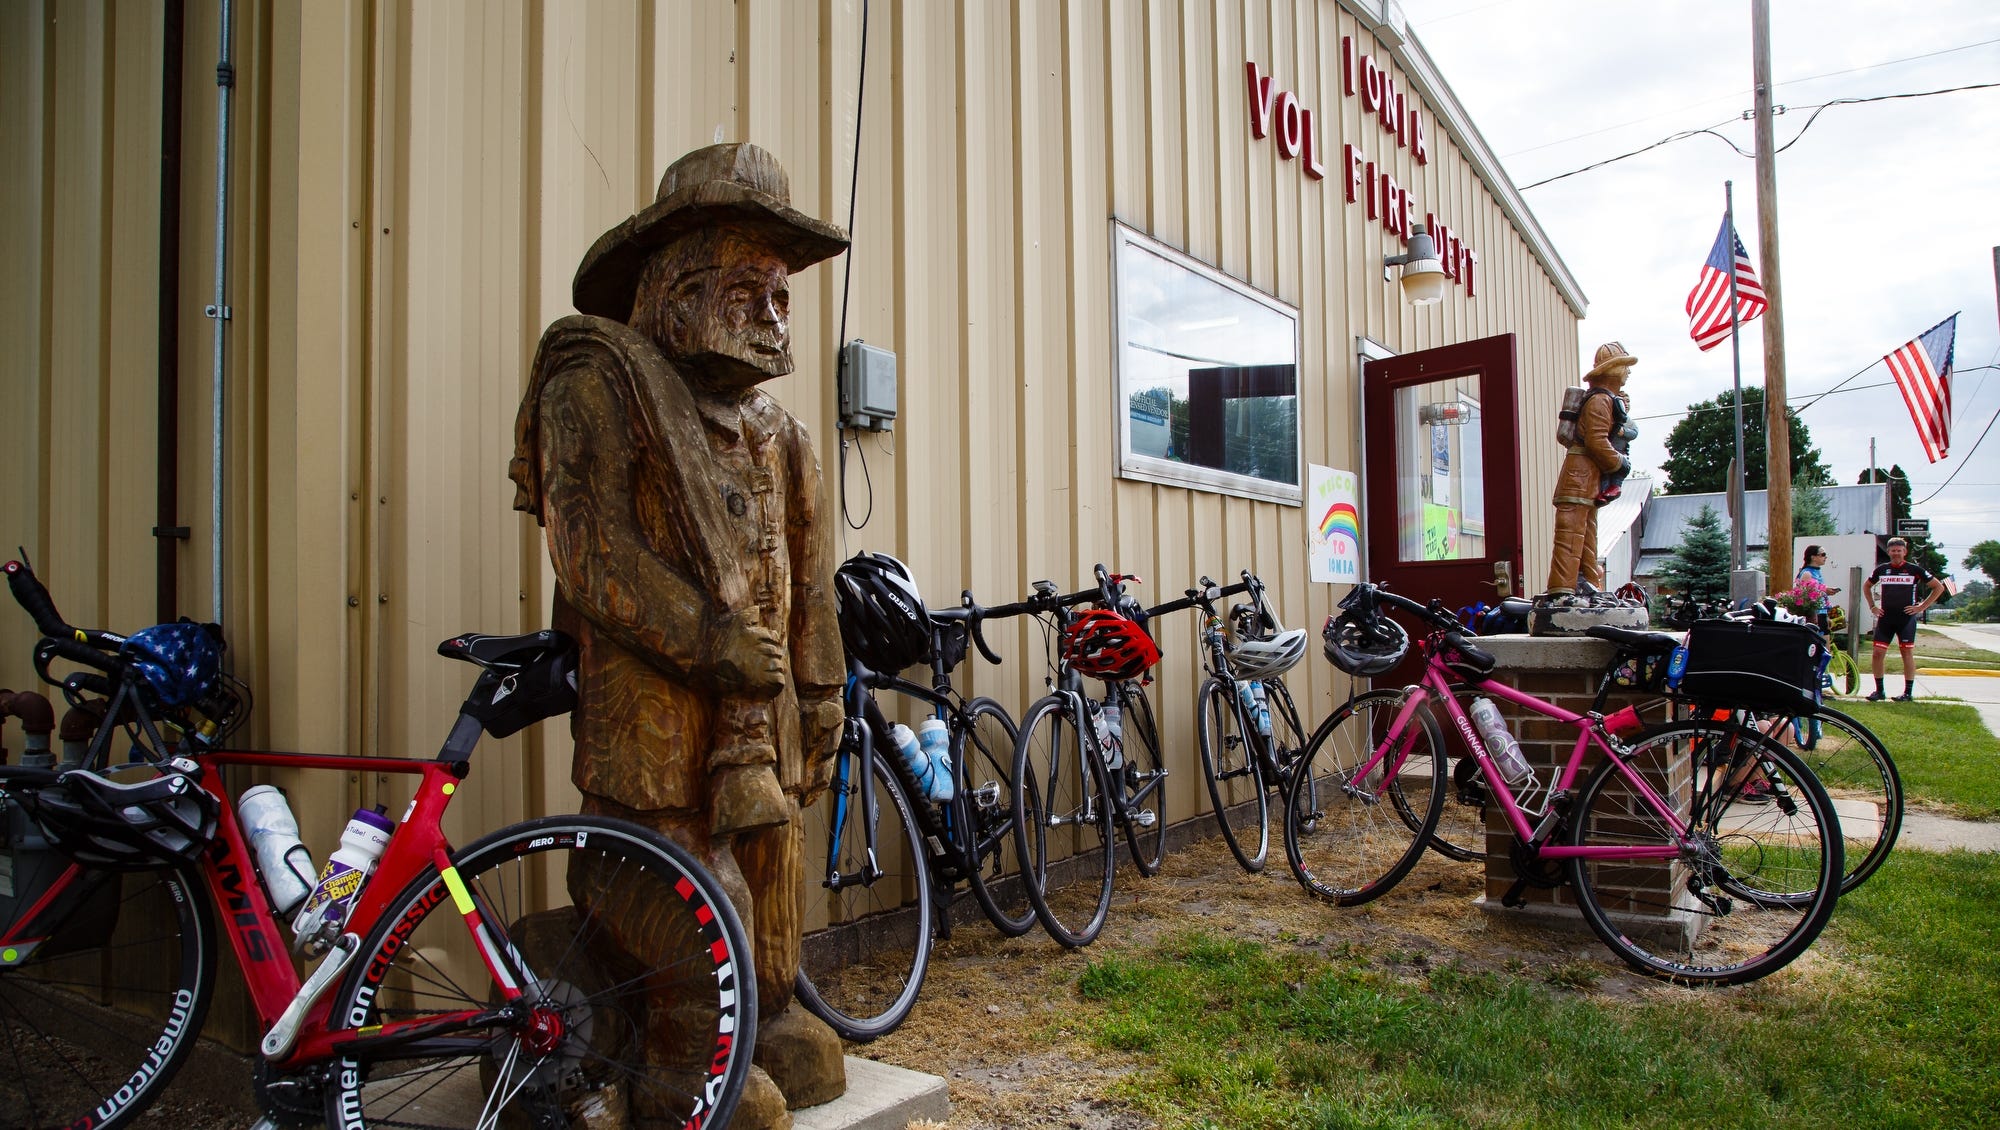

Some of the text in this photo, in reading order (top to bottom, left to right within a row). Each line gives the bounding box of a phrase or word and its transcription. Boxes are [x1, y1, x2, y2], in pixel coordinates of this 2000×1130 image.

[1342, 36, 1428, 166] IONIA
[1246, 61, 1478, 297] VOL FIRE DEPT
[1318, 474, 1357, 500] WELCO
[1332, 539, 1346, 555] TO
[1328, 558, 1354, 574] IONIA
[888, 592, 909, 613] GIRO
[101, 632, 127, 643] PROF
[1457, 715, 1487, 759] GUNNAR
[528, 836, 555, 849] AERO
[167, 880, 184, 903] AERO
[323, 870, 362, 891] Chamois
[329, 877, 362, 901] Butt
[209, 836, 274, 963] AMIS
[366, 882, 447, 984] classic
[1665, 962, 1714, 973] ALPHA
[97, 989, 193, 1121] american
